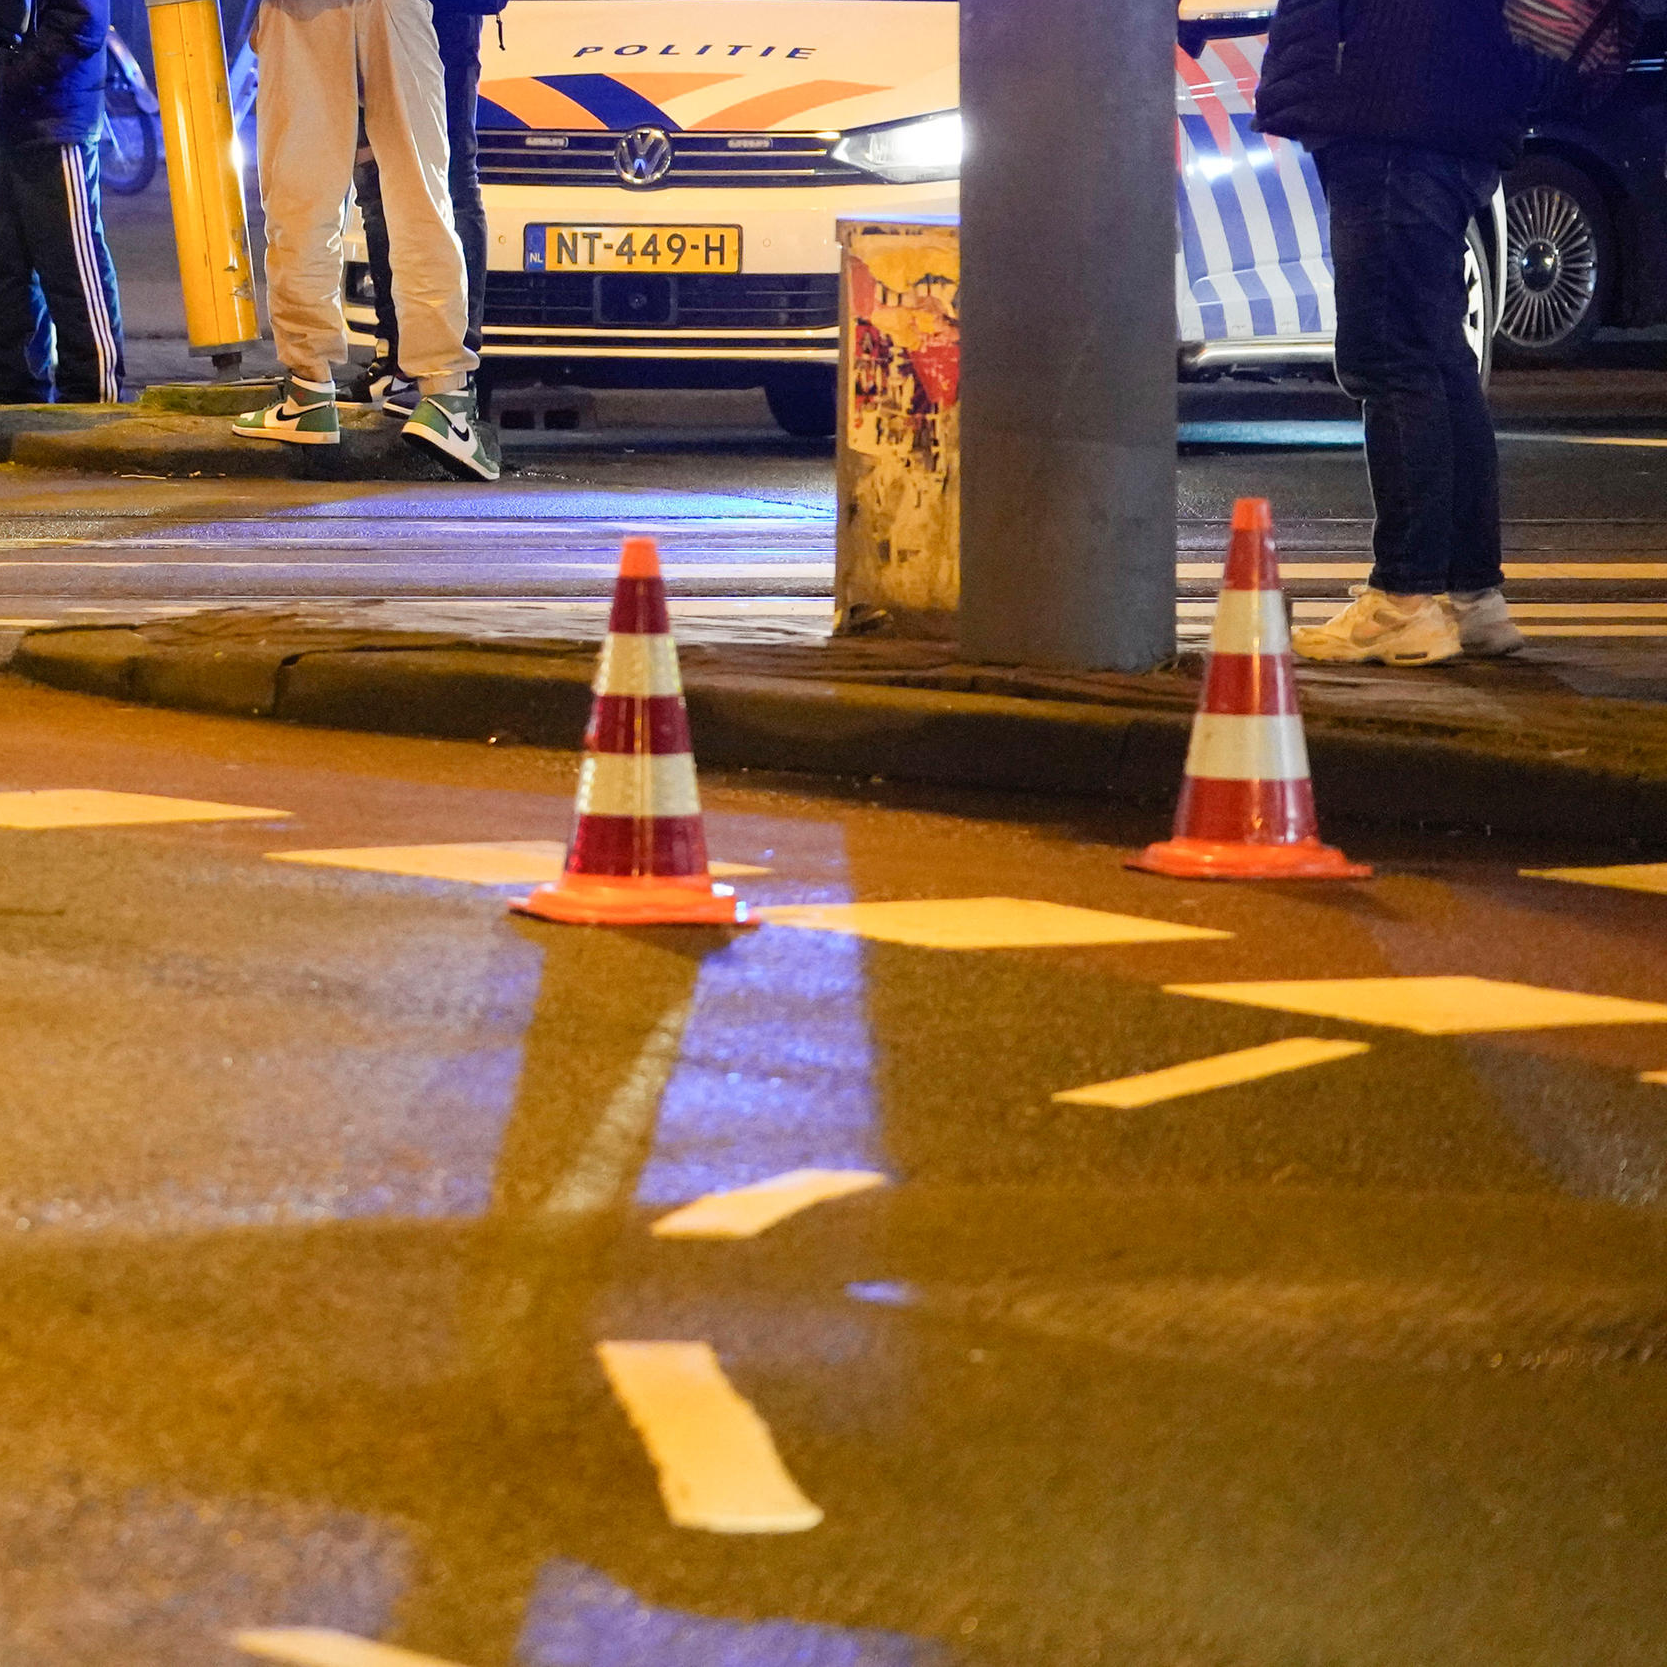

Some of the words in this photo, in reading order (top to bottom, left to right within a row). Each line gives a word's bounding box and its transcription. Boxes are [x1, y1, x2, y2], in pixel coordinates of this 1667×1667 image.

[573, 44, 817, 60] POLITIE
[557, 232, 725, 266] NT-449-H
[529, 252, 543, 263] NL
